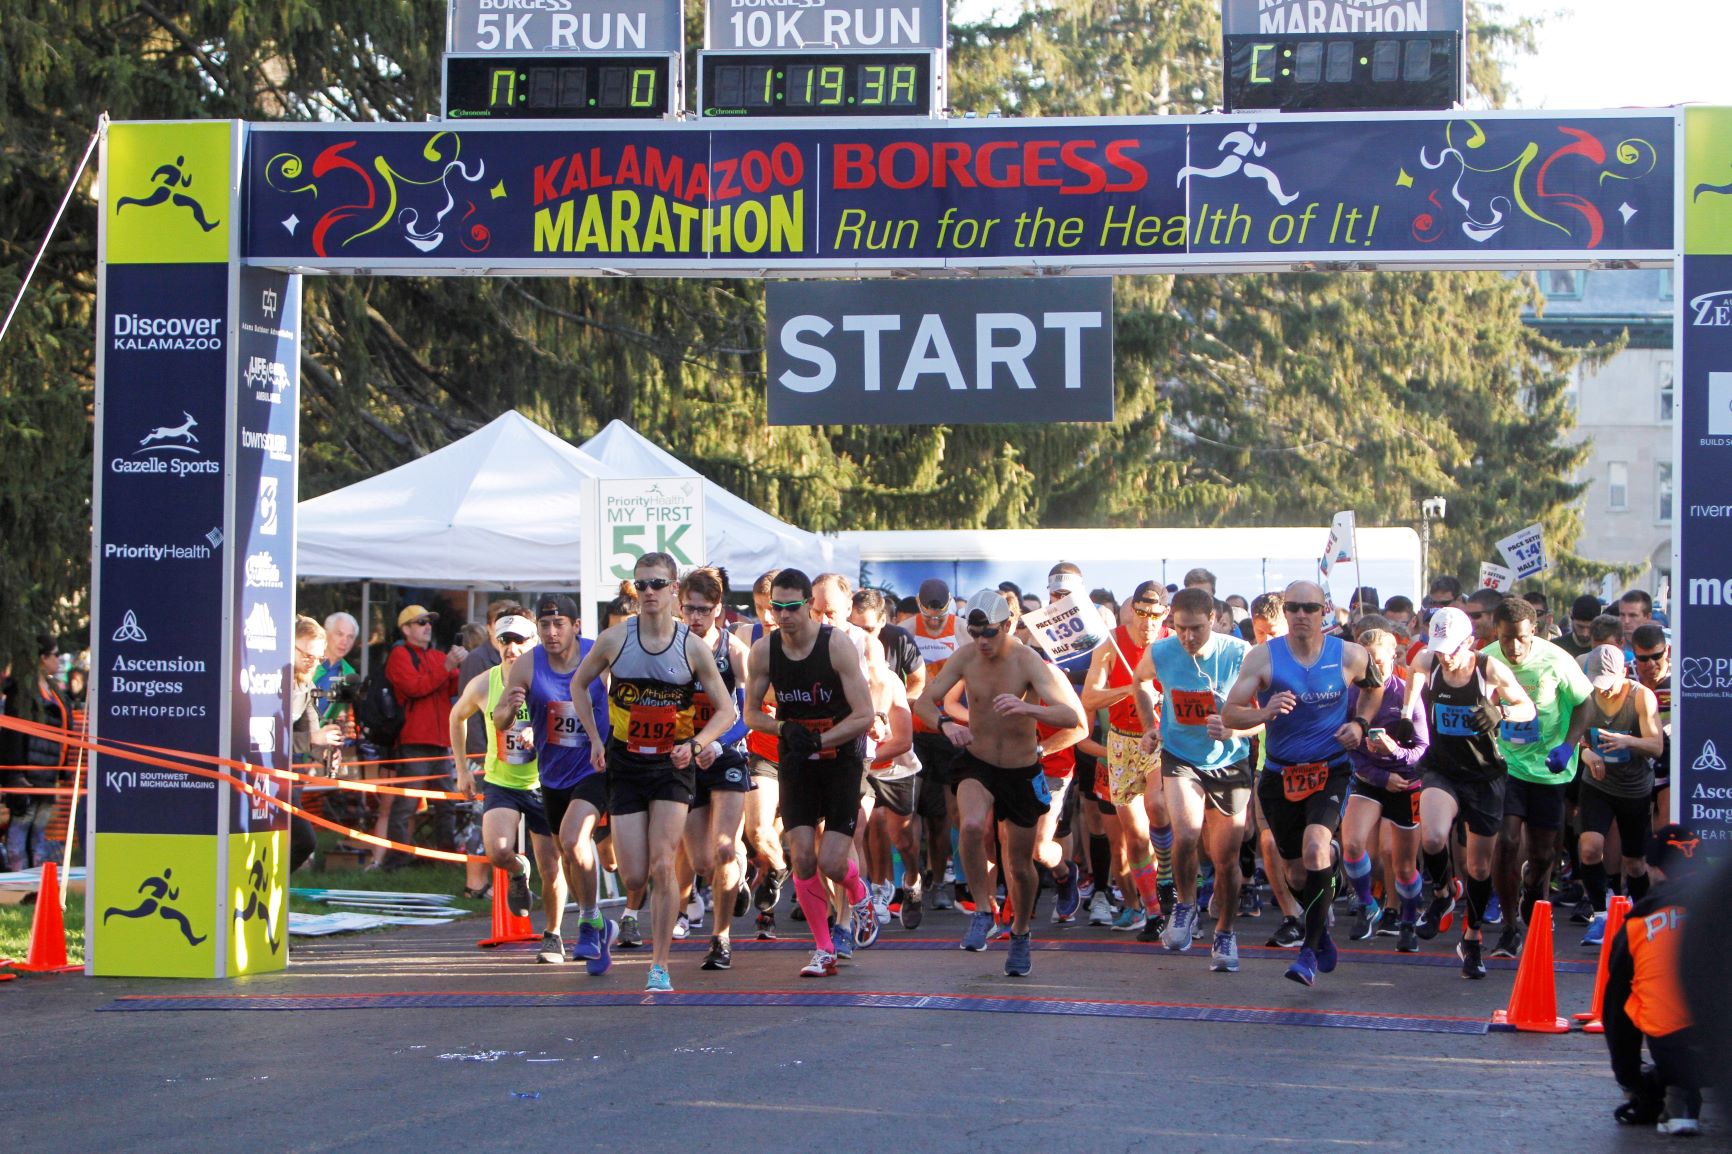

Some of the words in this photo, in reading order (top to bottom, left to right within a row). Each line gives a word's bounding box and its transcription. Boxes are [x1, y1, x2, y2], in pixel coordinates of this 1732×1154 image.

[1260, 0, 1428, 34] MARATHON
[476, 13, 534, 50] 5K
[551, 12, 646, 50] RUN
[731, 11, 804, 48] 10K
[823, 8, 921, 46] RUN
[533, 142, 805, 206] KALAMAZOO
[833, 139, 1148, 194] BORGESS
[533, 190, 805, 253] MARATHON
[834, 208, 919, 250] Run
[936, 207, 1000, 249] for
[1014, 206, 1084, 248] the
[1100, 202, 1263, 247] Health
[1268, 202, 1317, 245] of
[1335, 205, 1380, 246] It!
[114, 313, 221, 336] Discover
[114, 338, 221, 350] KALAMAZOO
[778, 311, 1102, 393] START
[111, 457, 168, 474] Gazelle
[170, 458, 220, 476] Sports
[607, 495, 685, 507] PriorityHealth
[607, 507, 636, 523] MY
[646, 506, 693, 522] FIRST
[105, 543, 210, 561] PriorityHealth
[1052, 606, 1080, 624] SETTER
[1045, 617, 1085, 642] 1:30
[1051, 643, 1071, 655] HALF
[112, 654, 206, 673] Ascension
[112, 676, 183, 696] Borgess
[111, 705, 206, 717] ORTHOPEDICS
[629, 720, 675, 739] 2192
[140, 772, 188, 780] SOUTHWEST
[140, 780, 180, 788] MICHIGAN
[181, 781, 215, 790] IMAGING
